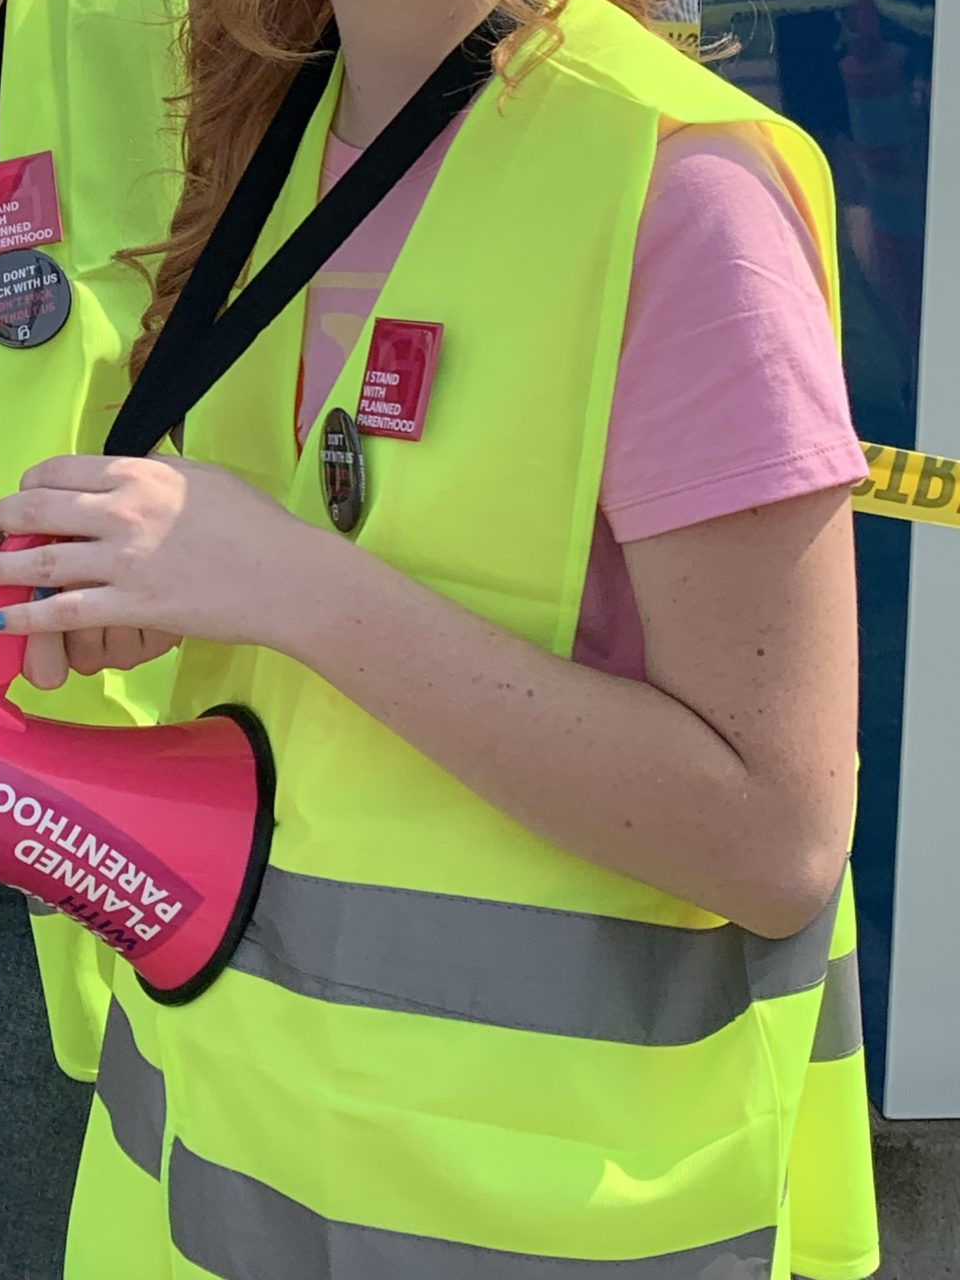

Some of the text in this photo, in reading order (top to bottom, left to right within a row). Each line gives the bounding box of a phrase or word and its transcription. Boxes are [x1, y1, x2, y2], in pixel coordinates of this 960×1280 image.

[3, 265, 36, 283] DON'T
[13, 278, 41, 294] WITH
[42, 273, 58, 286] US
[370, 371, 400, 385] STAND
[363, 385, 386, 398] WITH
[359, 399, 401, 415] PLANNED
[356, 413, 415, 432] PARENTHOOD
[14, 839, 161, 942] PLANNED
